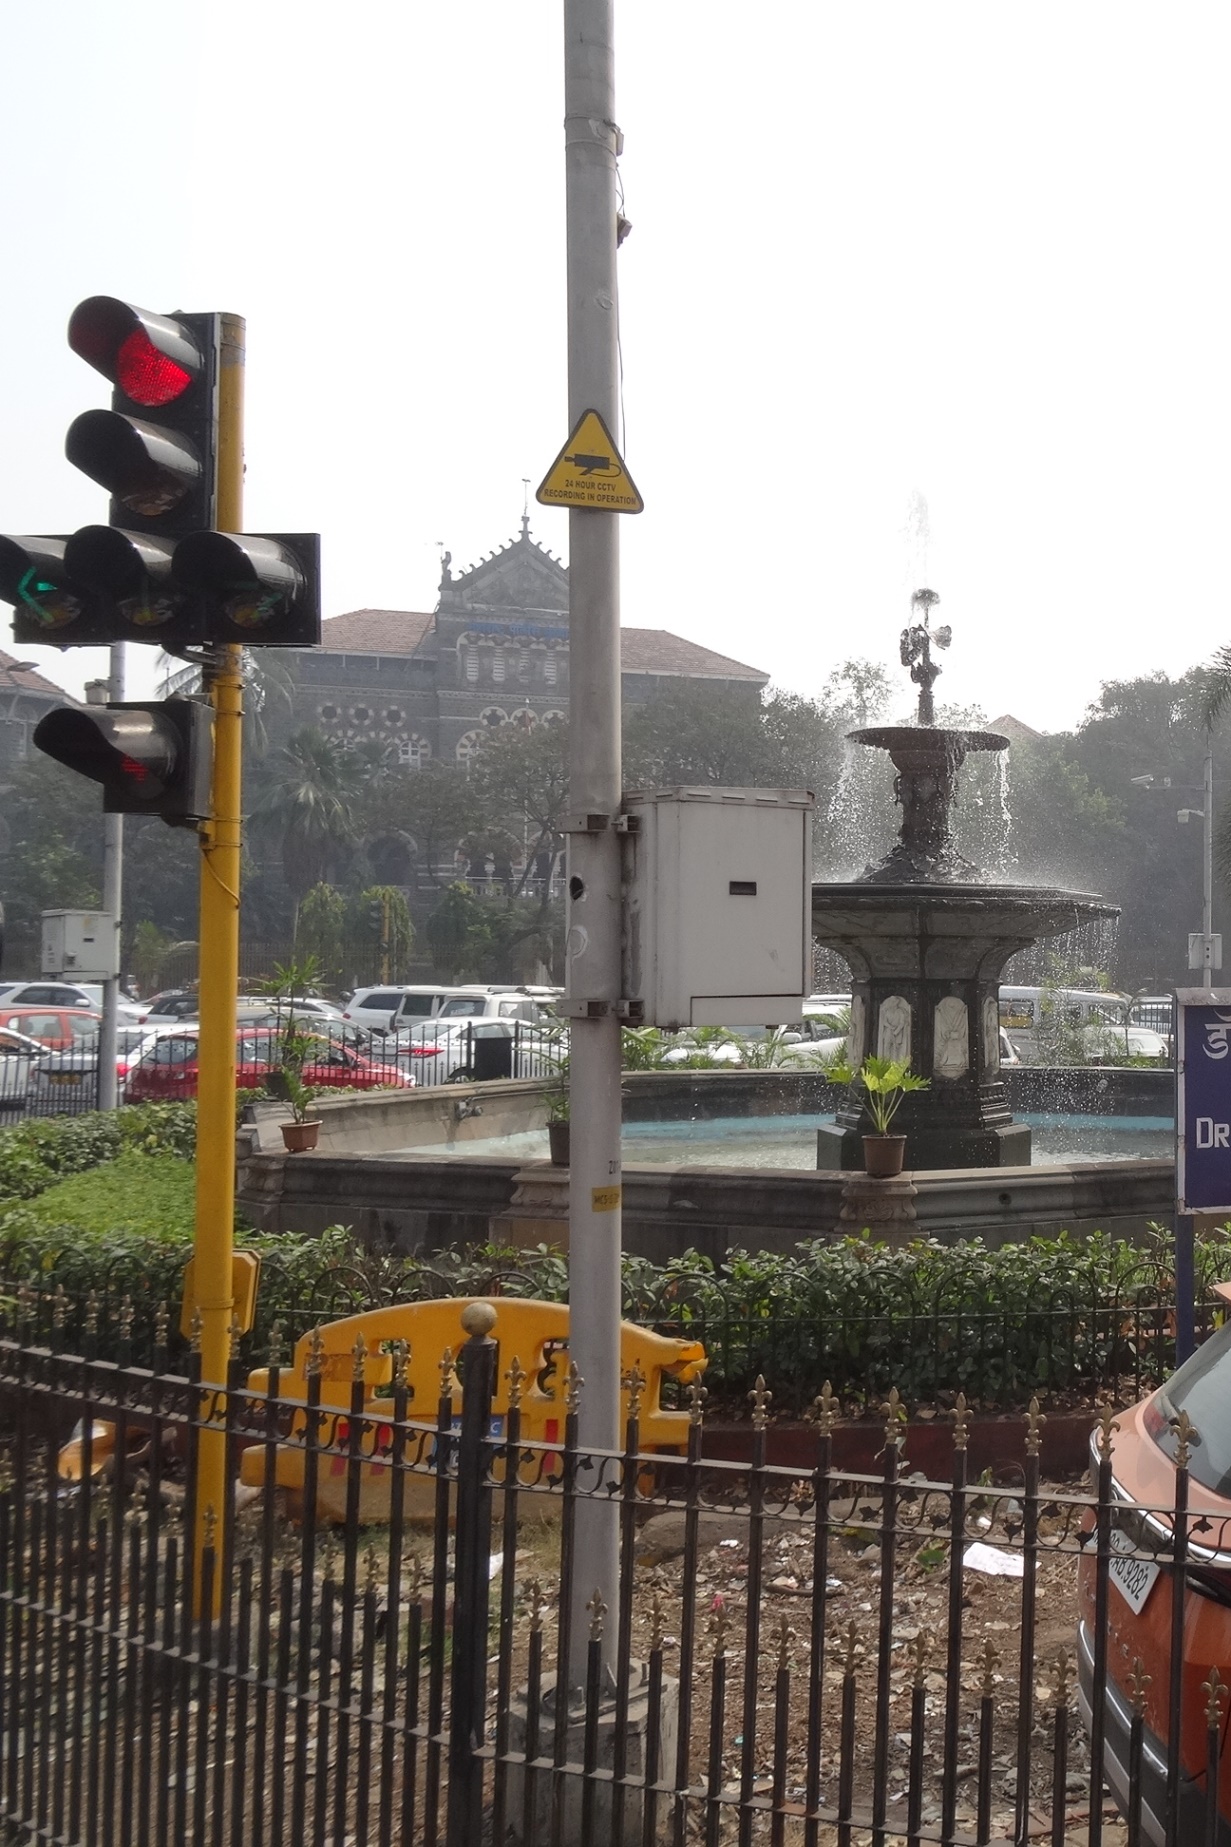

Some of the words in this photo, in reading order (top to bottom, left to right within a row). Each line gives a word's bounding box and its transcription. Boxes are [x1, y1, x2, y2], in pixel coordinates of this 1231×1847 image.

[565, 479, 574, 487] 24
[575, 481, 595, 490] HOUR
[597, 483, 617, 491] CCTV
[544, 488, 586, 500] RECORDING
[587, 493, 595, 501] IN
[596, 494, 636, 505] OPERATION
